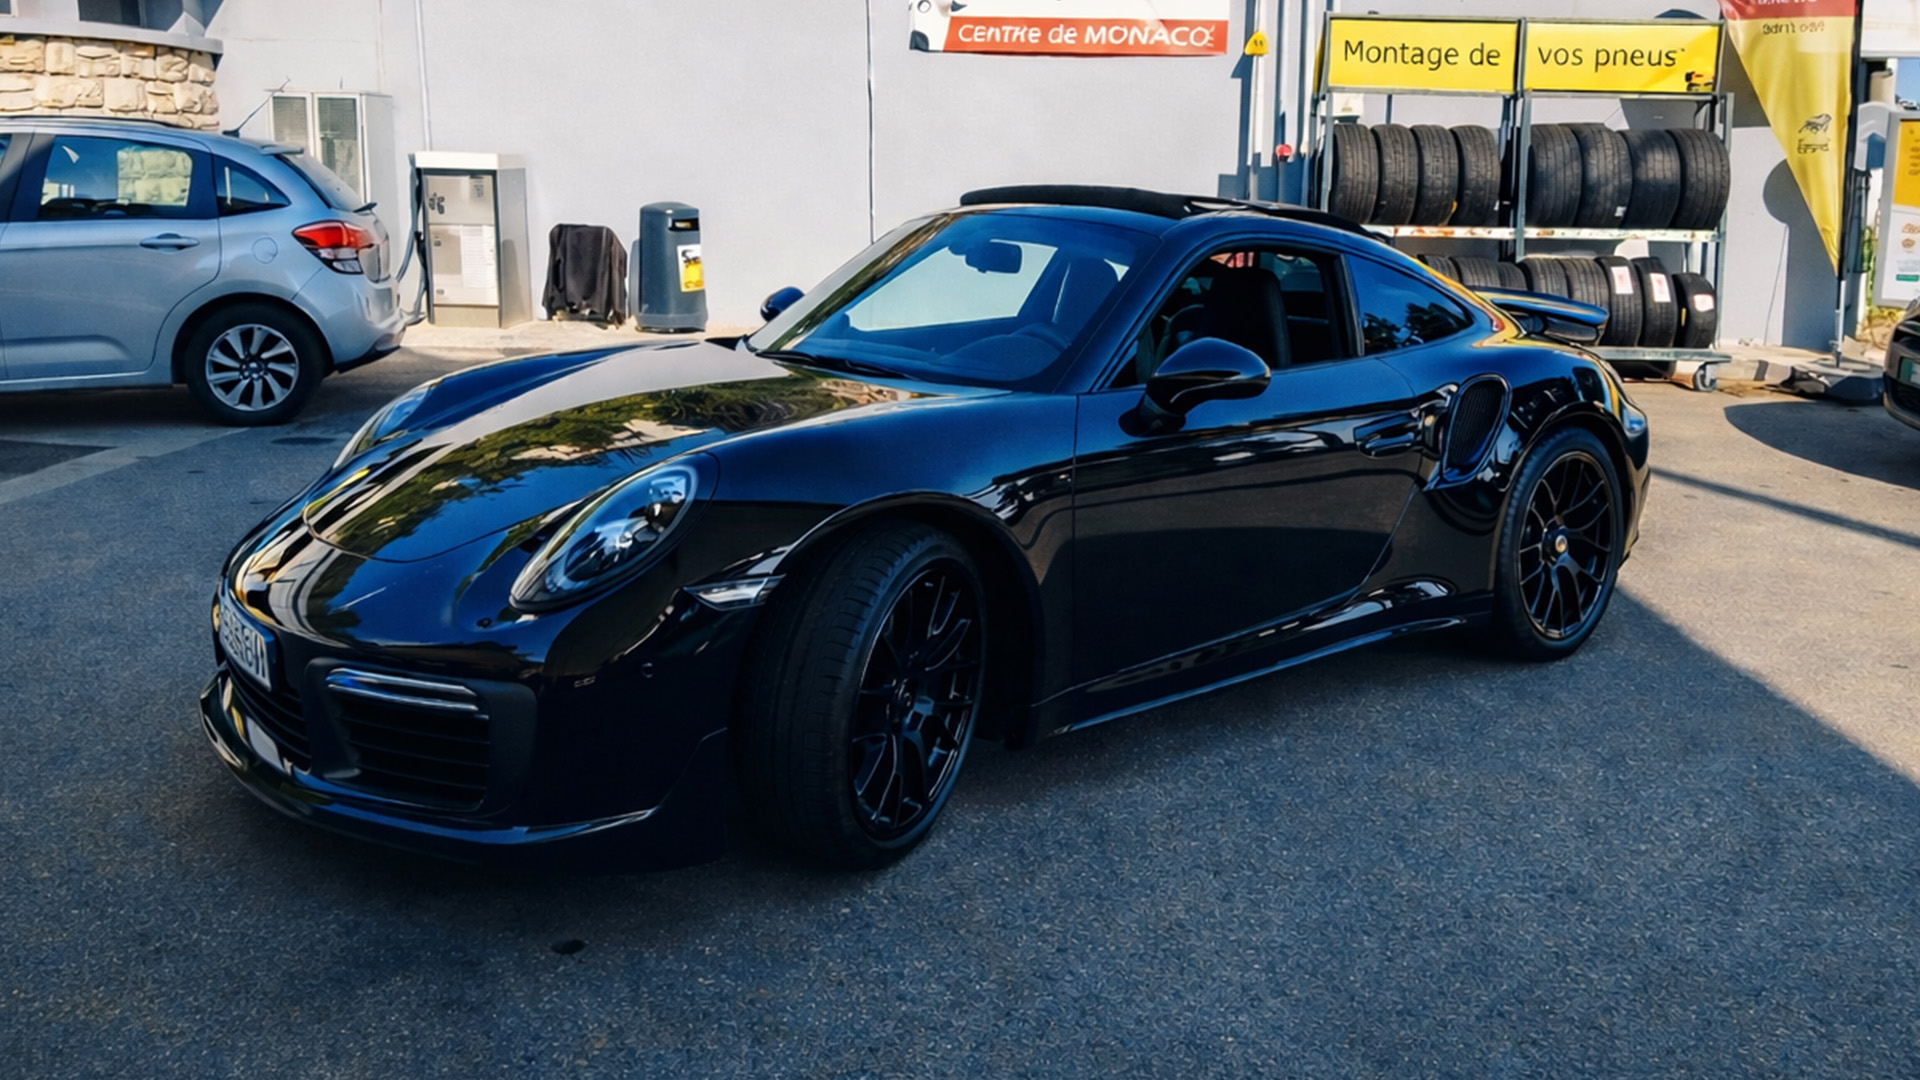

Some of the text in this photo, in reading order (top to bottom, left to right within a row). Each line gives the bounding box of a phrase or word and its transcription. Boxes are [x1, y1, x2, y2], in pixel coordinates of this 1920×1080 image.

[1048, 24, 1077, 44] de
[1084, 25, 1211, 46] MONACO
[1344, 39, 1678, 73] Montage de vos pneus
